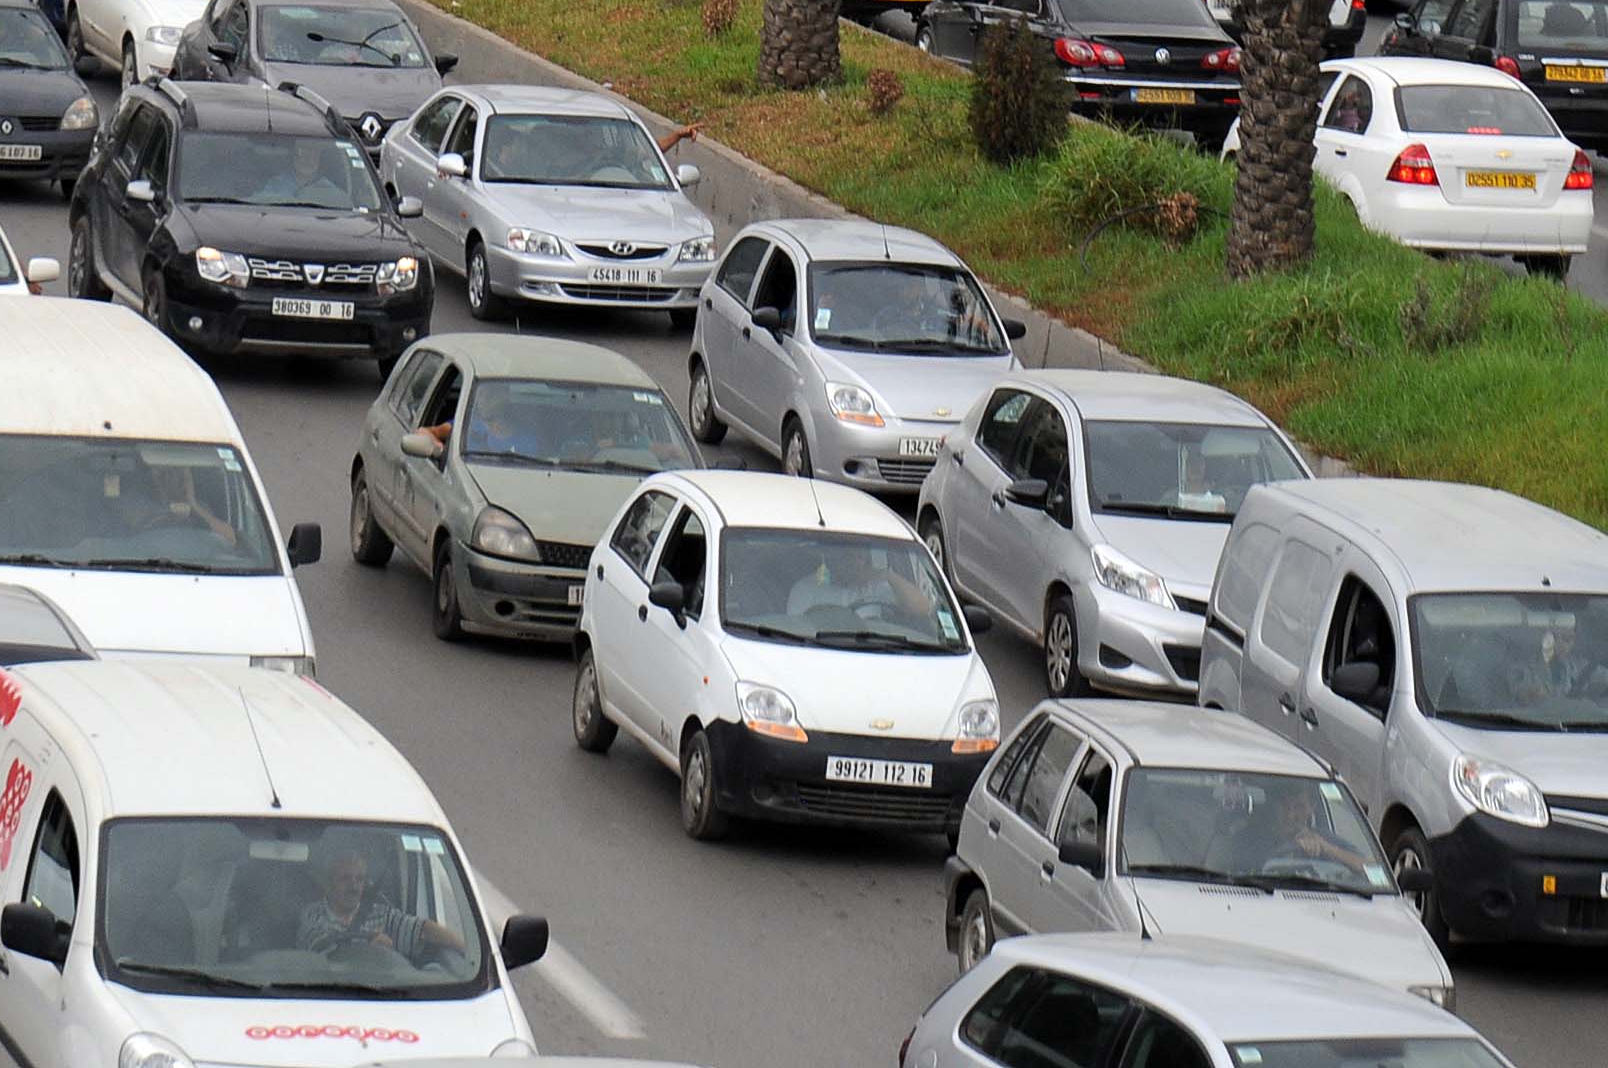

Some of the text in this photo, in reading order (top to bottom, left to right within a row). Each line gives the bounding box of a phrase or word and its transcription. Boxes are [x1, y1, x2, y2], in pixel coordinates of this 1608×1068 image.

[1468, 172, 1498, 187] 02551
[1521, 174, 1535, 189] 35
[593, 268, 657, 283] 45418 111 16
[274, 300, 352, 317] 380369 00 16
[835, 759, 926, 786] 99121 112 16
